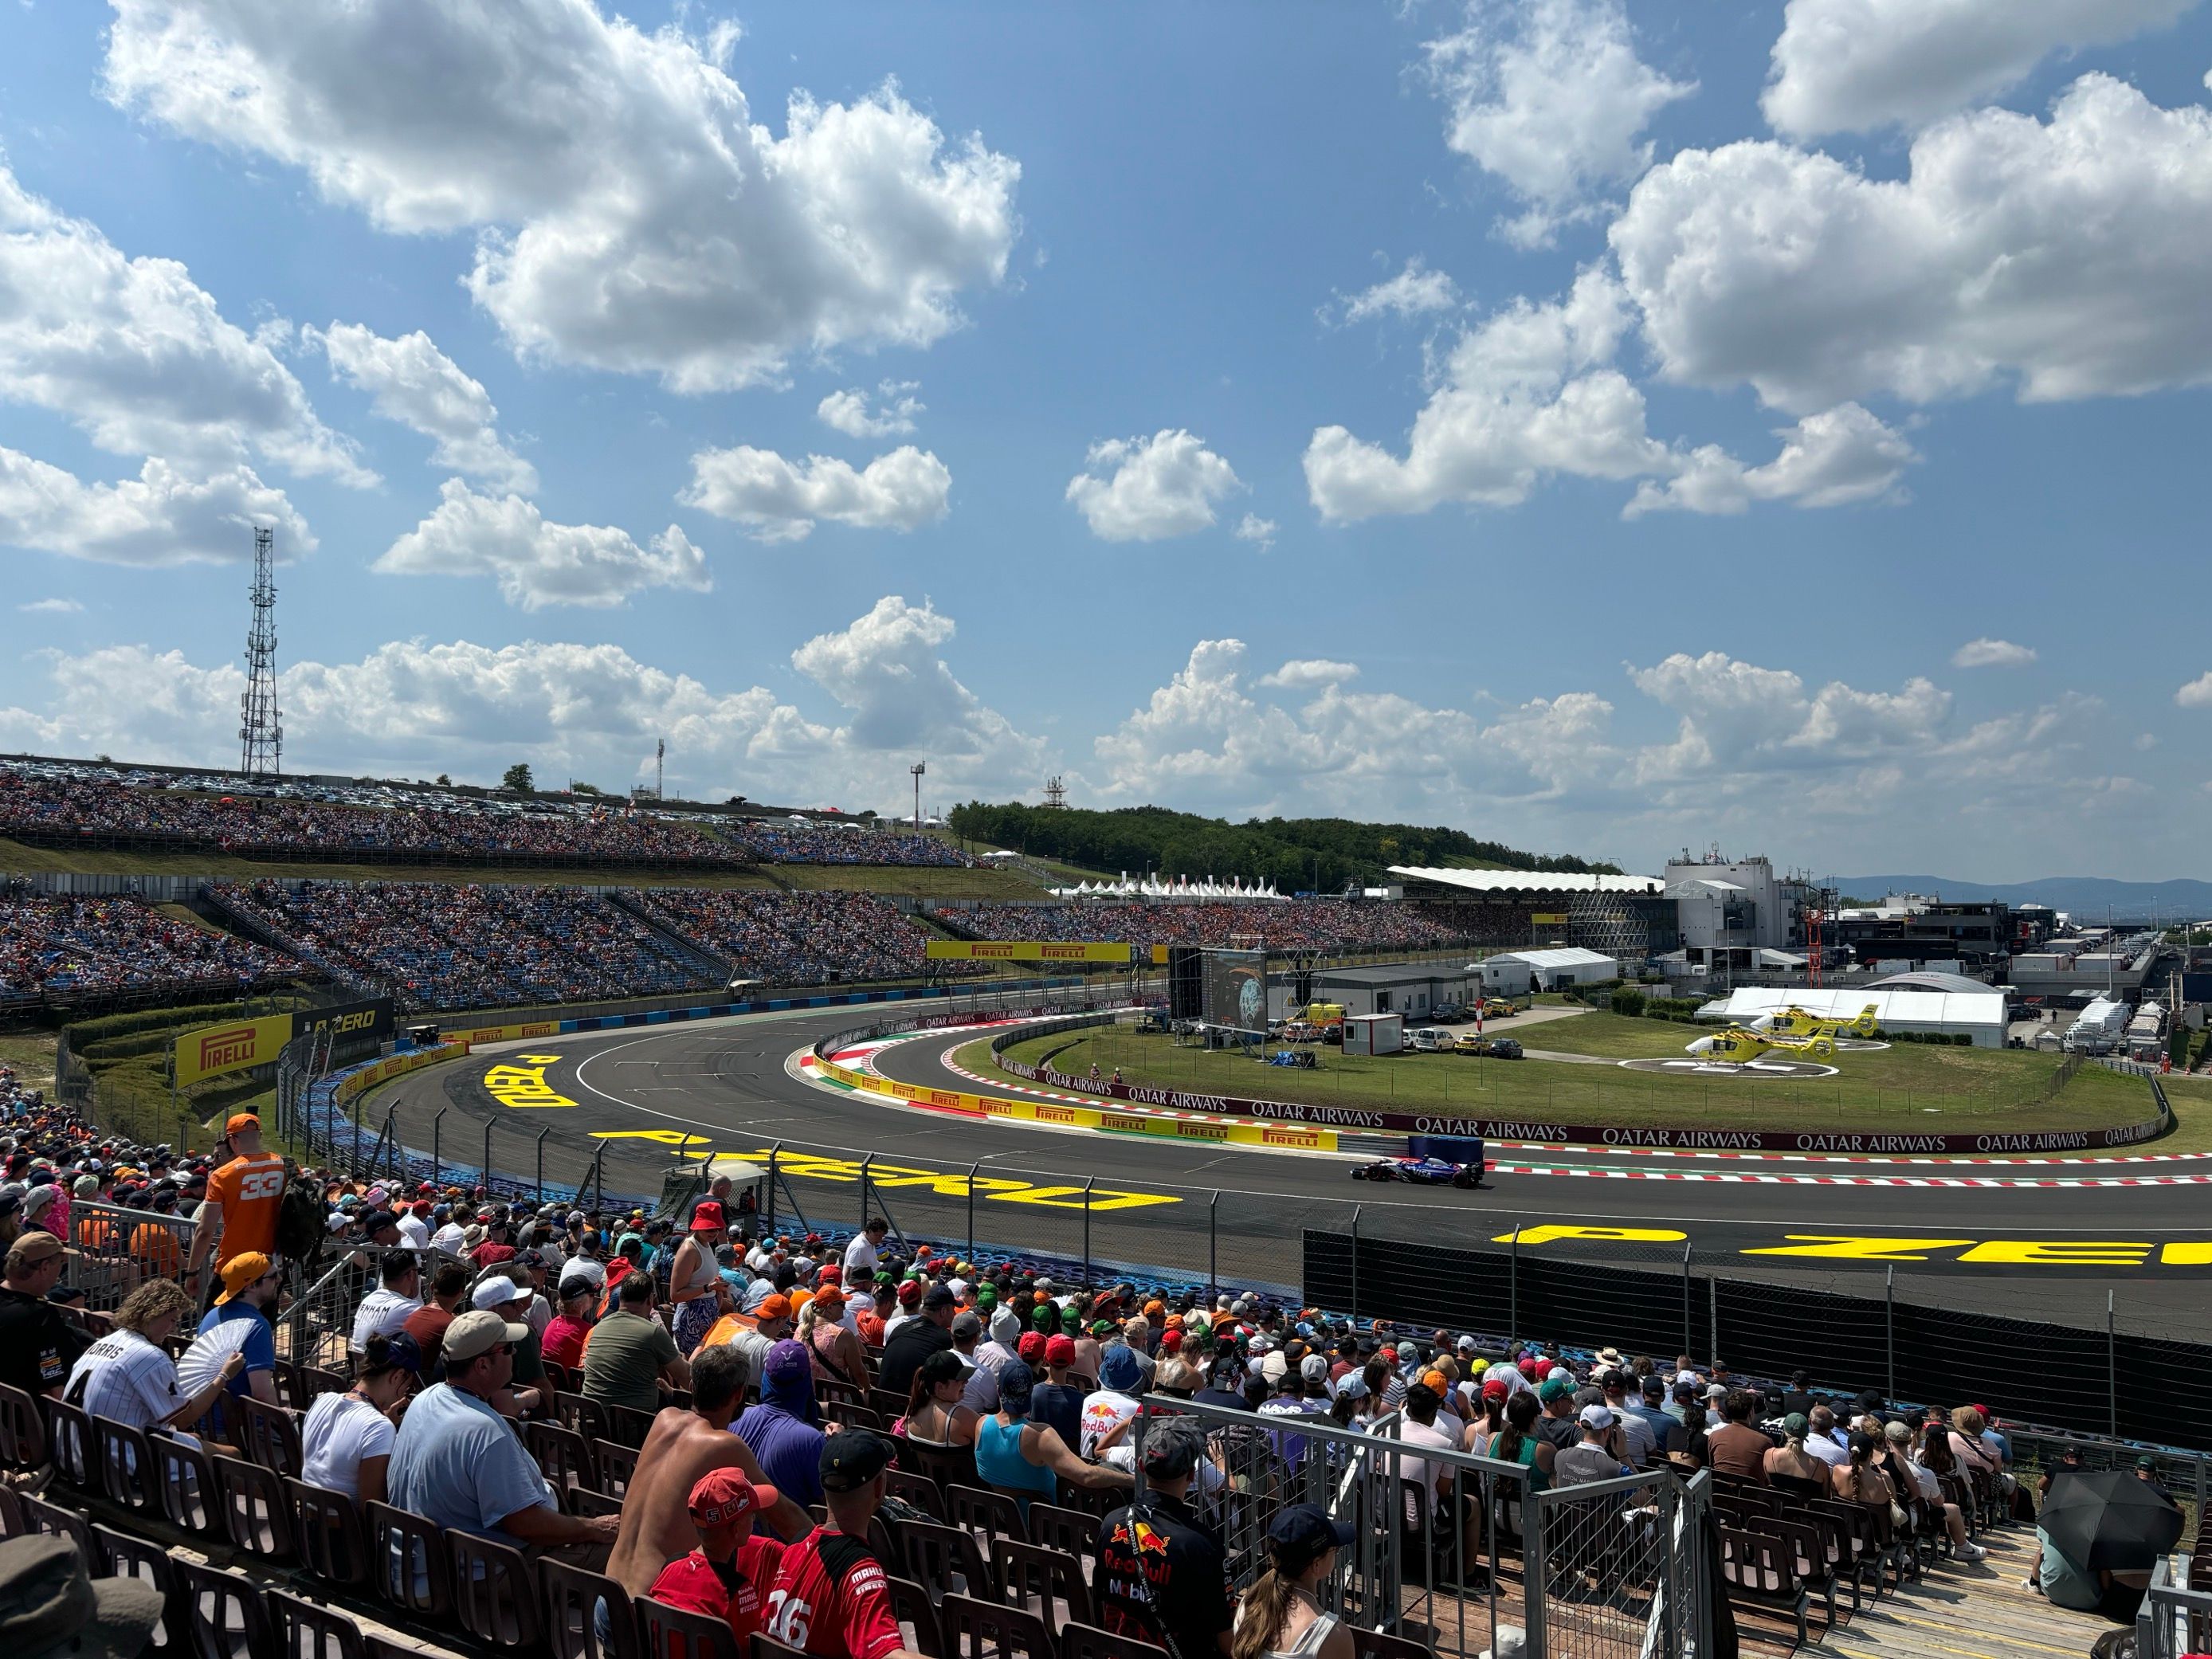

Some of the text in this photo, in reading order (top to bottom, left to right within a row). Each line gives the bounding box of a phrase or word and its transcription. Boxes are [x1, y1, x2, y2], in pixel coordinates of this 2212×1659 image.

[971, 944, 1013, 956] PIRELLI
[1041, 945, 1085, 958] PIRELLI
[1041, 1003, 1085, 1016] QATAR AIRWAYS
[1094, 998, 1133, 1010] QATAR AIRWAYS
[332, 1010, 376, 1035] ZERO
[926, 1014, 975, 1028] QATAR AIRWAYS
[985, 1008, 1033, 1022] QATAR AIRWAYS
[473, 1029, 502, 1042] PIRELLI
[522, 1024, 551, 1037] PIRELLI
[877, 1021, 918, 1036] QATAR AIRWAYS
[200, 1027, 256, 1072] PIRELLI
[384, 1058, 402, 1075] PIRELLI
[411, 1055, 425, 1069] PIRELLI
[1002, 1057, 1036, 1080] QATAR AIRWAYS
[484, 1054, 580, 1108] P ZERO
[862, 1077, 880, 1092] PIRELLI
[1045, 1071, 1112, 1096] QATAR AIRWAYS
[892, 1083, 916, 1099] PIRELLI
[931, 1091, 960, 1107] PIRELLI
[1128, 1087, 1227, 1112] QATAR AIRWAYS
[979, 1098, 1013, 1115] PIRELLI
[1035, 1105, 1075, 1122] PIRELLI
[1252, 1101, 1383, 1128] QATAR AIRWAYS
[1101, 1113, 1147, 1131] PIRELLI
[1177, 1121, 1229, 1139] PIRELLI
[1415, 1116, 1567, 1142] QATAR AIRWAYS
[1262, 1128, 1318, 1147] PIRELLI
[1602, 1128, 1763, 1150] QATAR AIRWAYS
[1796, 1134, 1947, 1153] QATAR AIRWAYS
[1976, 1131, 2088, 1153] QATAR AIRWAYS
[2105, 1127, 2134, 1146] QATAR
[587, 1130, 1183, 1210] P ZERO
[1413, 1168, 1432, 1179] VISA
[240, 1171, 284, 1201] 33
[1491, 1225, 2212, 1265] P ZE
[1098, 1421, 1120, 1433] Bu
[1562, 1473, 1578, 1482] ASTON
[767, 1589, 812, 1650] 16
